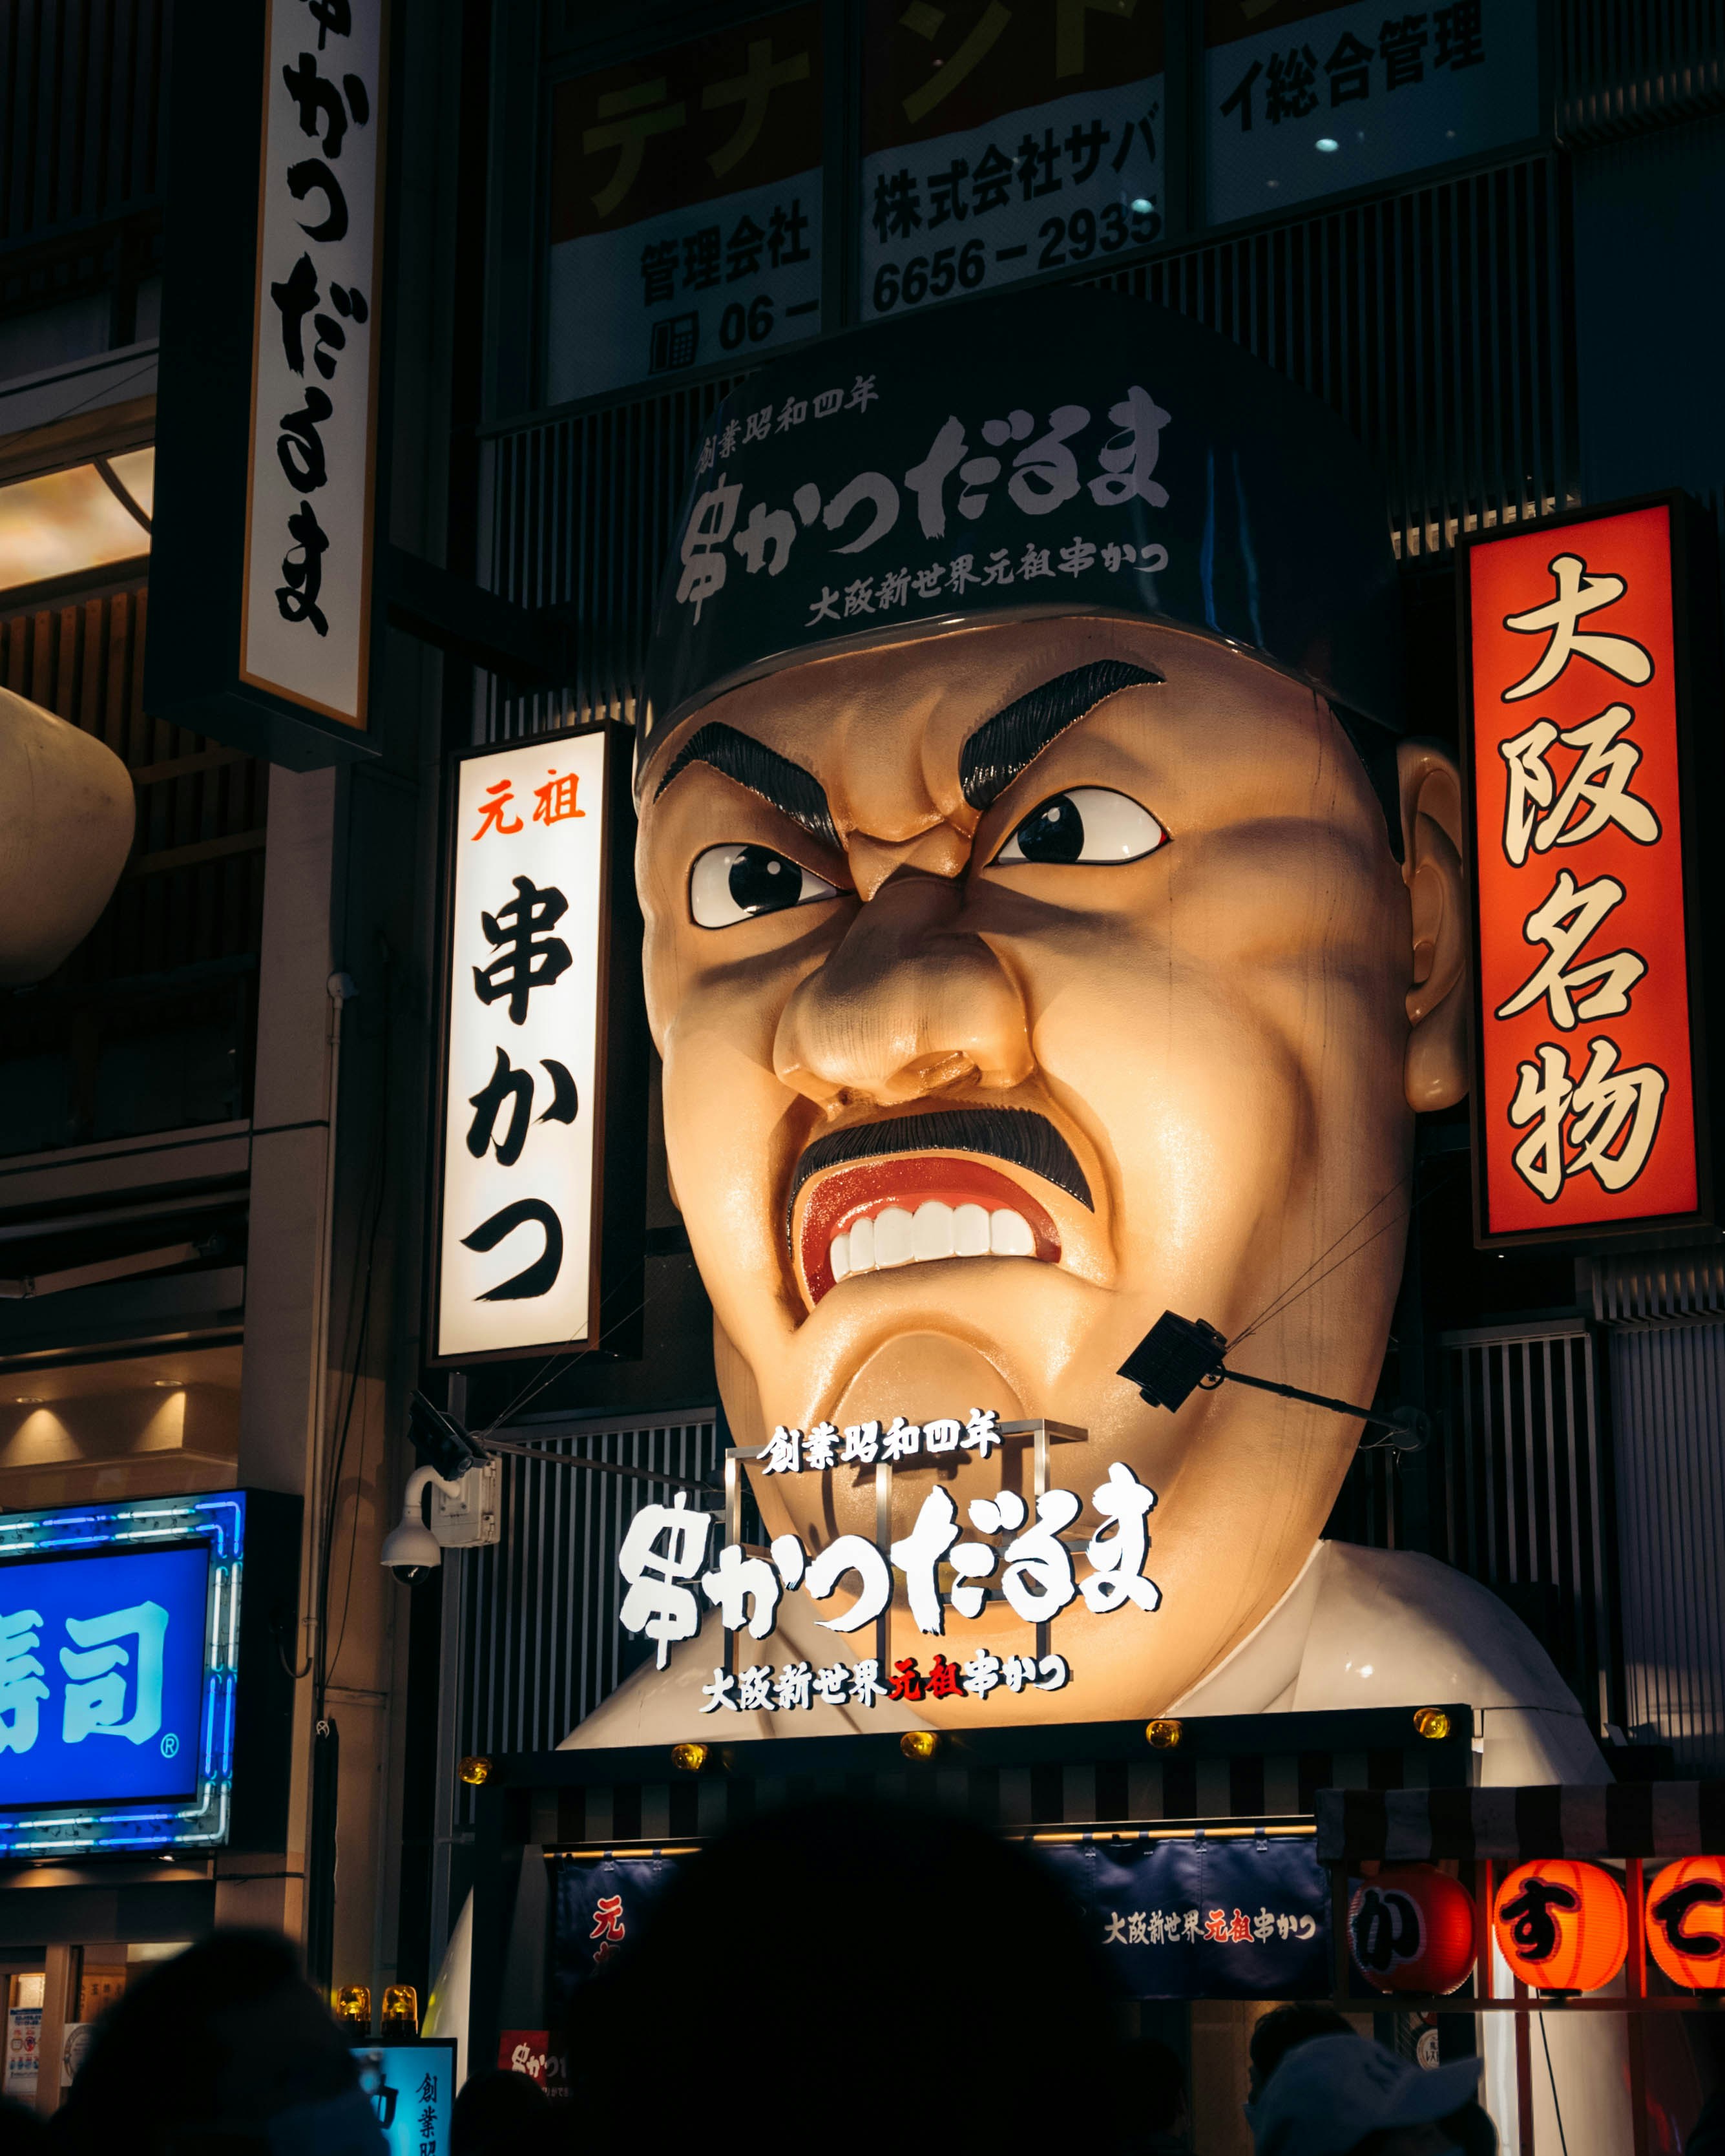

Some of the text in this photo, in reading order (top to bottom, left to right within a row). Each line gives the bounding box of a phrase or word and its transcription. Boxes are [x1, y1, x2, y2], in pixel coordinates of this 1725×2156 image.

[640, 199, 810, 308] 管理会社
[694, 374, 879, 474] 創業昭和四年
[676, 385, 1173, 626] 串かつだるま
[803, 536, 1169, 627] 大阪新世界元祖串かつ
[470, 769, 587, 841] 元祖
[1494, 552, 1669, 1204] 大阪名物
[459, 875, 579, 1301] 串かつ
[756, 1407, 1004, 1475] 創業昭和四年
[618, 1461, 1162, 1671] 串かつだるま
